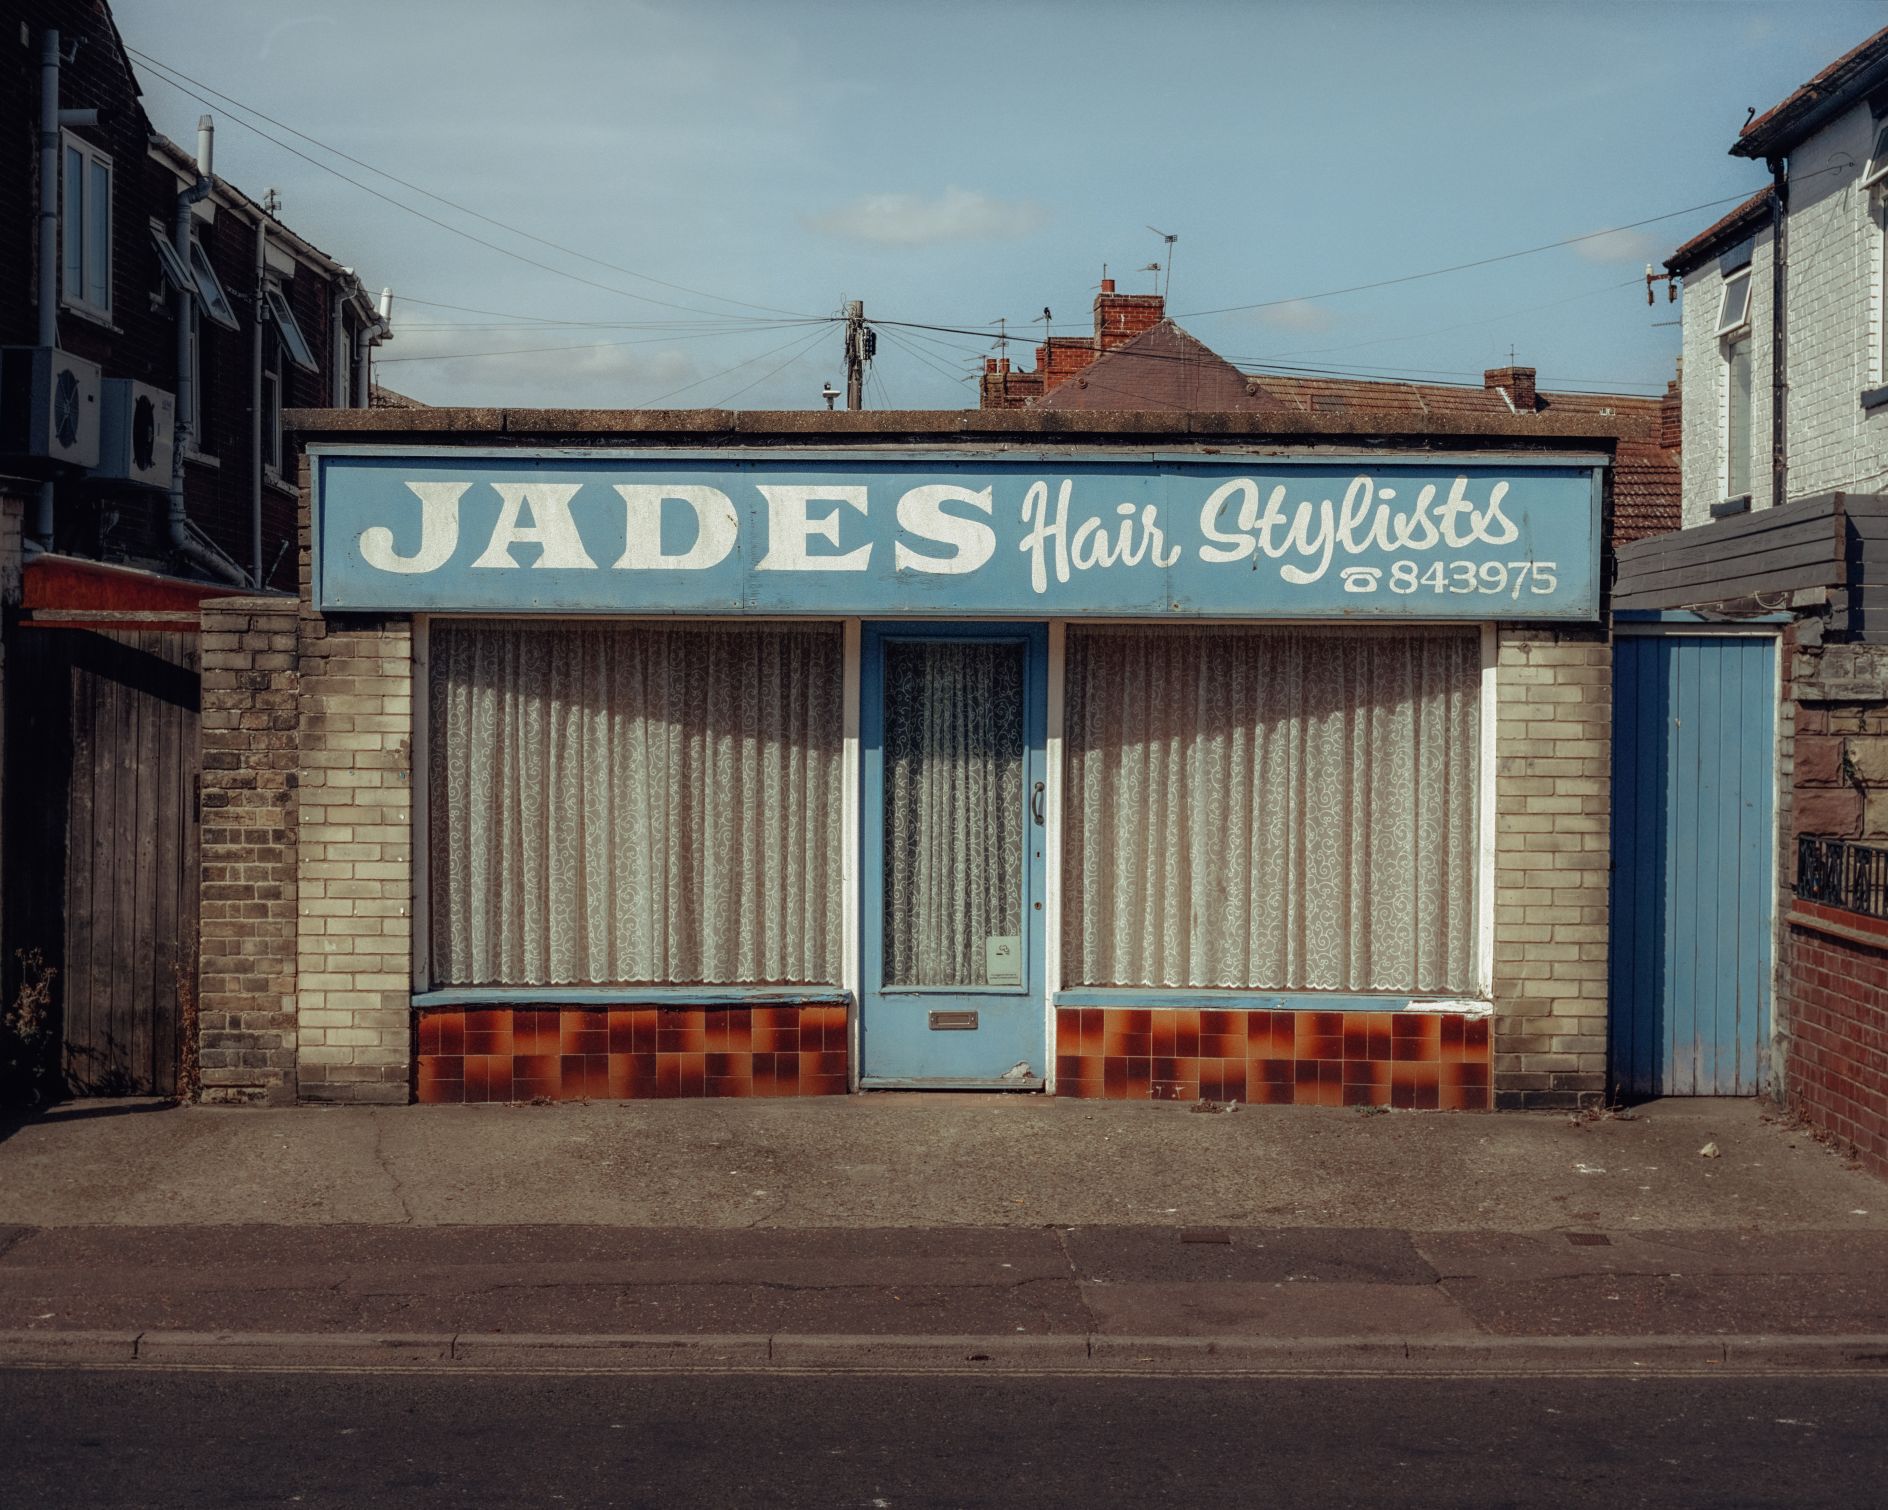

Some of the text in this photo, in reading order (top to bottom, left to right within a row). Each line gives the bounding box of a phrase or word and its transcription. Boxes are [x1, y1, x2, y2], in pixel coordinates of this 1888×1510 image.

[359, 474, 1519, 594] JADES Hair Stylists
[1389, 560, 1557, 600] 843975
